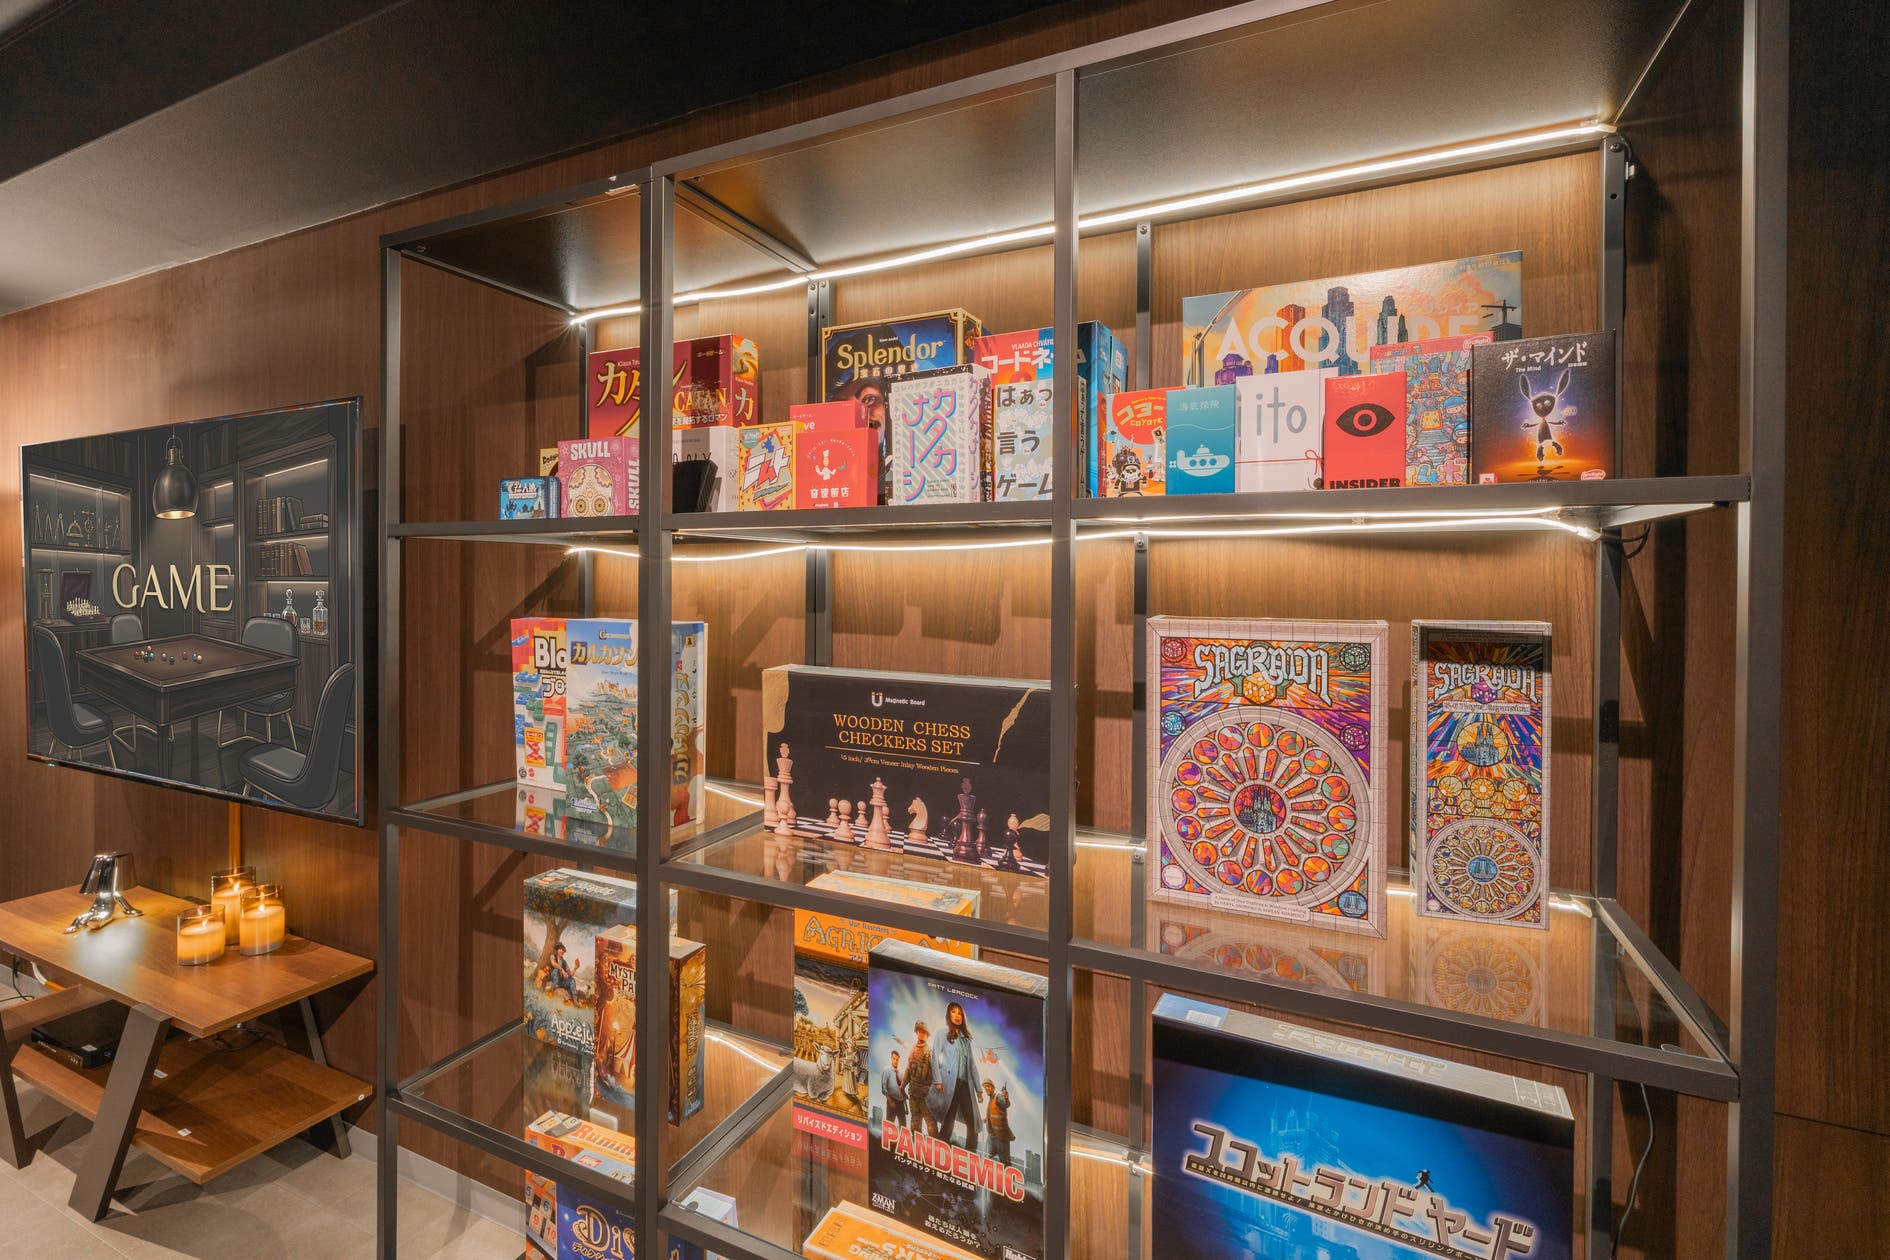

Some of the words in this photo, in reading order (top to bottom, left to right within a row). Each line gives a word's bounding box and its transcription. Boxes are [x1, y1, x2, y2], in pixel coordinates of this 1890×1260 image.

[837, 333, 944, 382] Splendor
[981, 347, 1054, 374] コードネ
[1501, 341, 1588, 370] ザ・マインド
[674, 387, 727, 412] CATAN
[1117, 401, 1165, 426] コヨー
[1129, 416, 1164, 427] COYOTE
[1255, 386, 1307, 444] ito
[570, 440, 611, 461] SKULL
[997, 430, 1040, 455] 言う
[627, 458, 640, 509] SKULL
[1329, 477, 1400, 490] INSIDER
[112, 563, 235, 614] GAME
[535, 637, 566, 669] Blo
[571, 641, 638, 667] カルカソン
[542, 676, 566, 698] ブロ
[1194, 643, 1332, 707] SAGRADA
[1434, 662, 1538, 704] SAGRADA
[885, 697, 909, 705] Magnetic
[833, 713, 904, 733] WOODEN
[913, 721, 971, 739] CHESS
[839, 730, 927, 752] CHECKERS
[931, 739, 964, 755] SET
[880, 759, 900, 767] Veneer
[900, 761, 915, 770] Inlay
[916, 763, 939, 772] Wooden
[940, 766, 959, 774] Pieces
[803, 915, 884, 953] AGRIC
[621, 979, 636, 994] PA
[946, 987, 979, 1000] LEACOCK
[797, 1113, 863, 1142] リバイズドエディション
[570, 1123, 636, 1161] Rumm
[881, 1119, 1025, 1203] PANDEMIC
[525, 1185, 532, 1197] 5
[1185, 1122, 1536, 1260] スコットランドヤード
[543, 1200, 550, 1212] 6
[533, 1215, 540, 1226] 9
[546, 1227, 557, 1240] 10
[572, 1204, 636, 1255] Di
